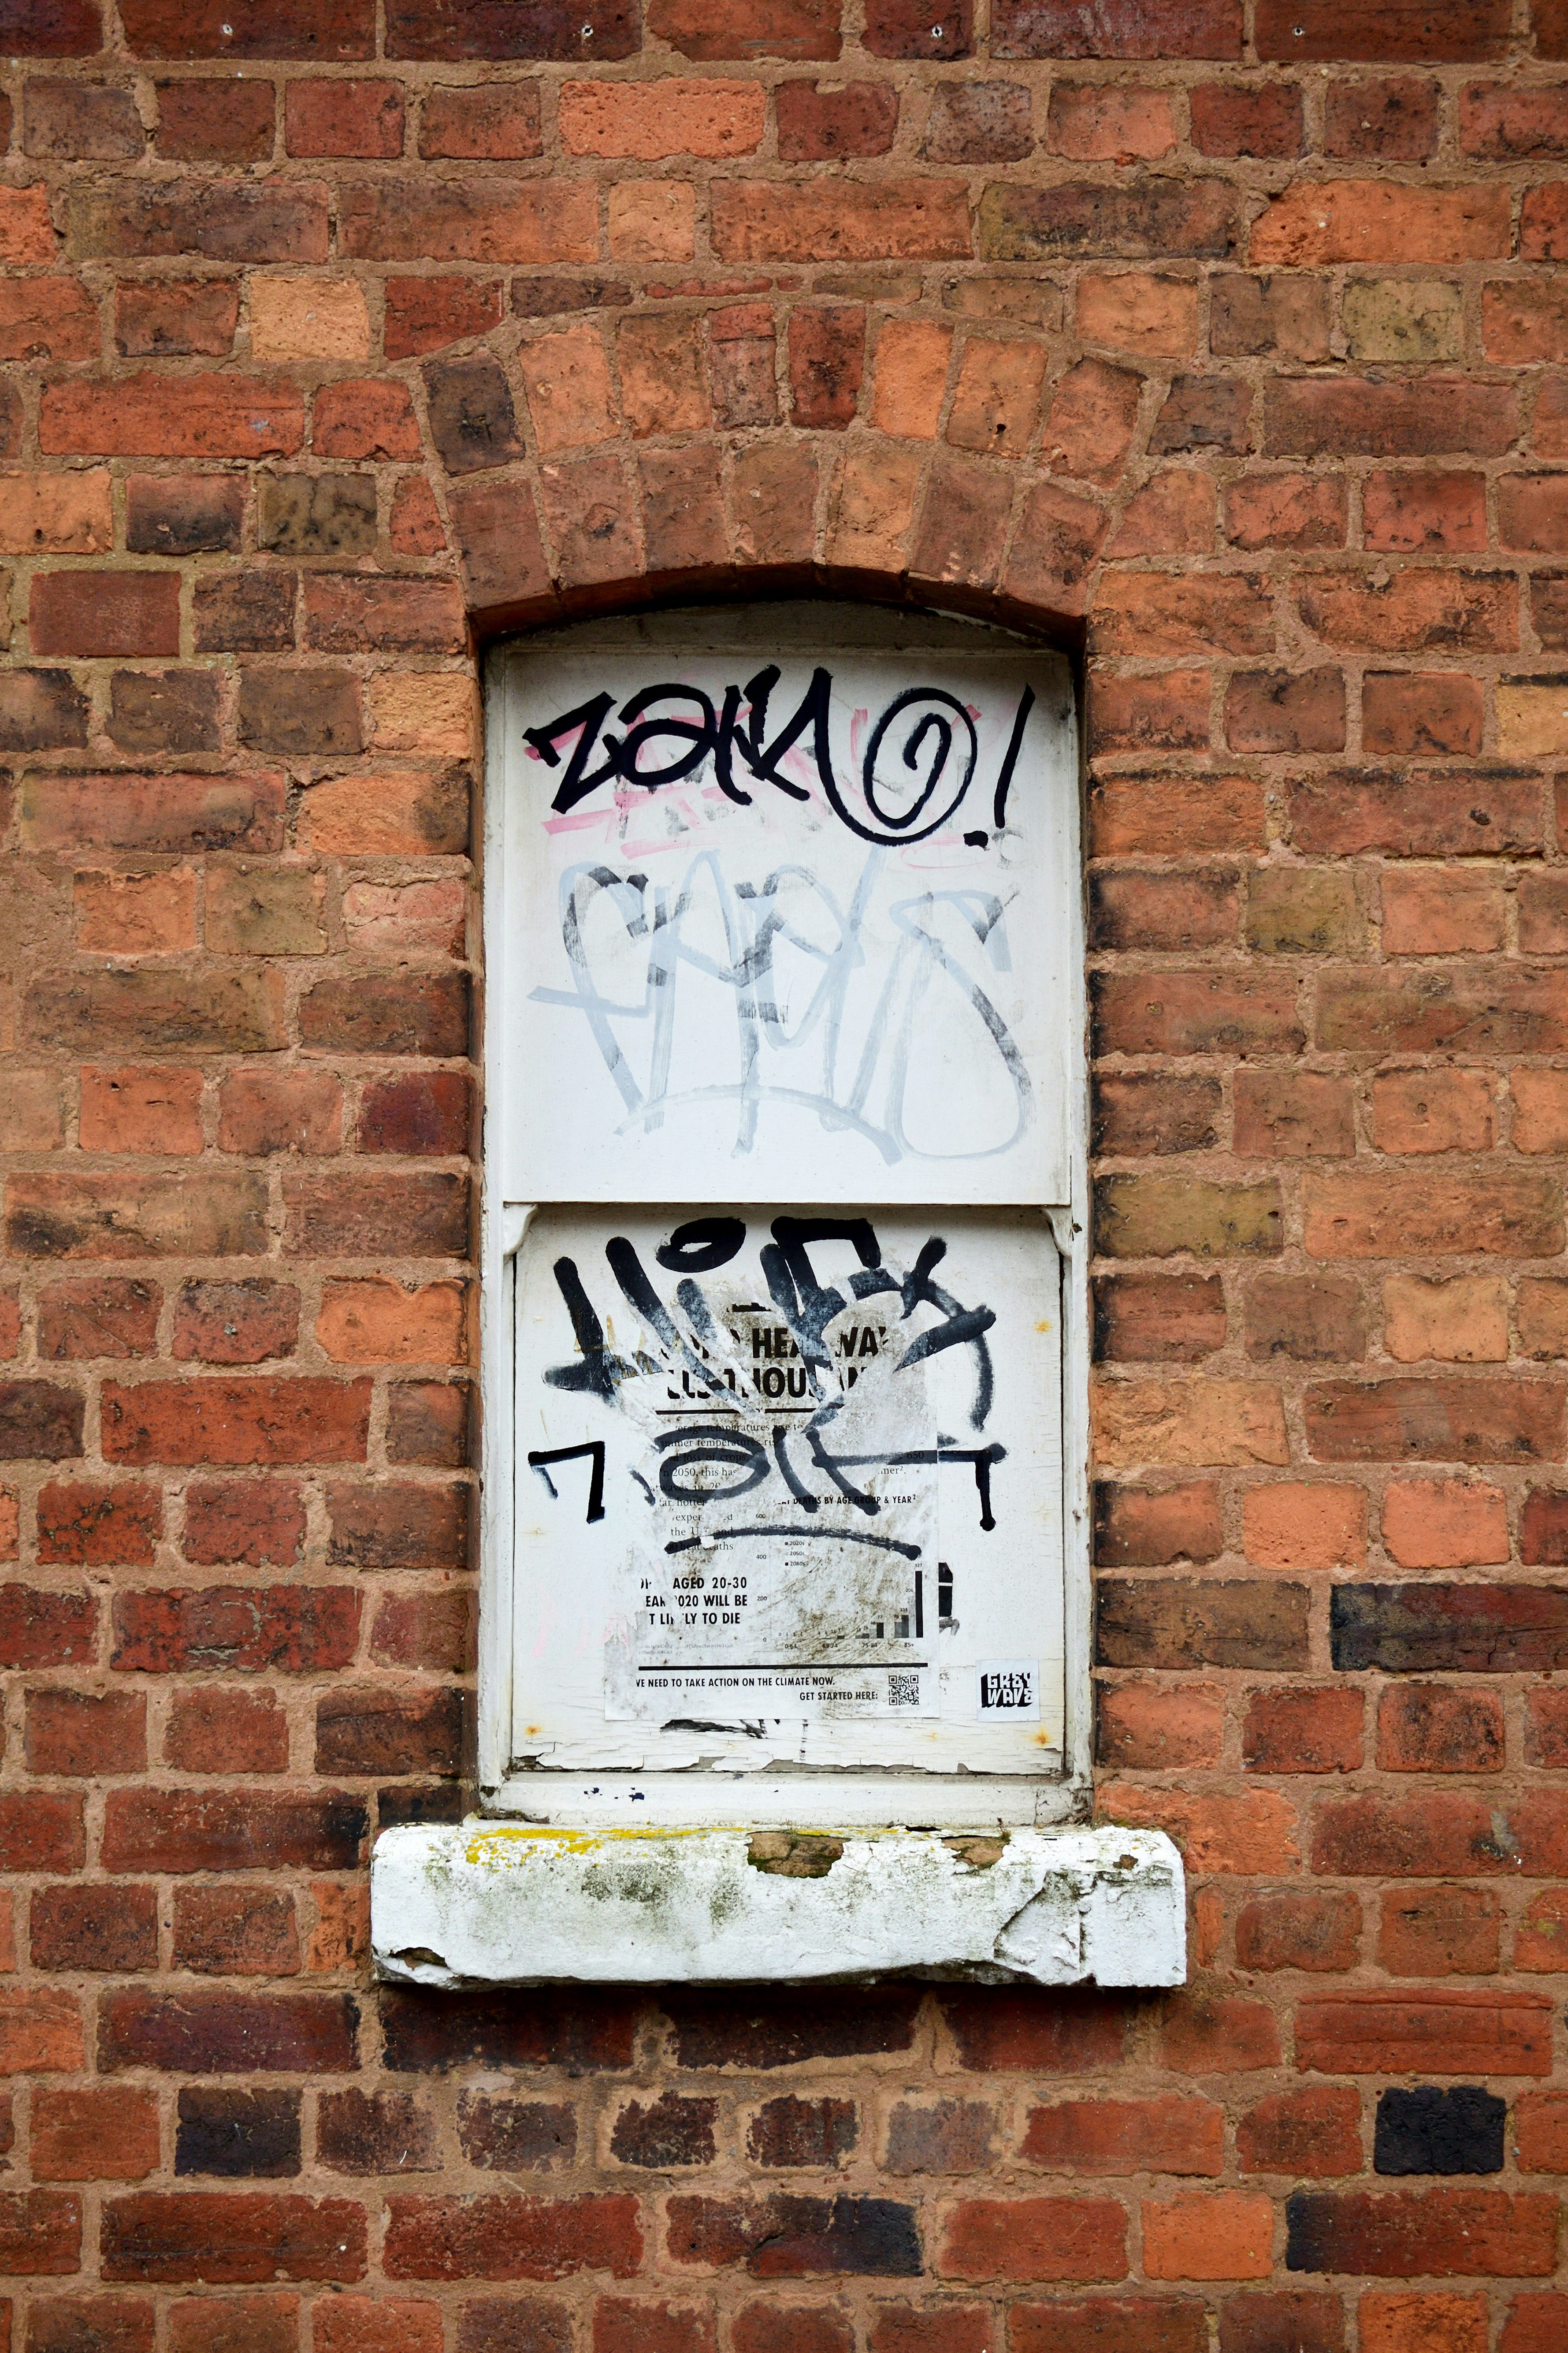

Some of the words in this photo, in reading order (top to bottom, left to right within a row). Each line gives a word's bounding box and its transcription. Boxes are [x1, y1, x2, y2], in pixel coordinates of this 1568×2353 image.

[707, 1423, 769, 1433] temperatures
[697, 1438, 762, 1448] temperatures
[684, 1452, 701, 1461] loss
[706, 1451, 716, 1460] of
[907, 1450, 924, 1459] 650
[673, 1468, 698, 1478] 2050,
[701, 1467, 719, 1476] this
[824, 1496, 834, 1504] BY
[837, 1496, 852, 1504] AGE
[855, 1496, 881, 1504] GROUP
[671, 1527, 686, 1536] the
[716, 1526, 733, 1535] and
[673, 1577, 704, 1589] AGED
[712, 1576, 747, 1589] 20-30
[674, 1595, 699, 1607] 020
[703, 1594, 730, 1607] WILL
[735, 1594, 747, 1606] BE
[702, 1612, 717, 1624] TO
[722, 1612, 740, 1624] DIE
[648, 1679, 668, 1687] NEED
[671, 1678, 682, 1687] TO
[685, 1678, 705, 1687] TAKE
[708, 1678, 739, 1687] ACTION
[742, 1678, 754, 1686] ON
[758, 1677, 773, 1686] THE
[775, 1677, 809, 1686] CLIMATE
[813, 1676, 835, 1685] NOW.
[799, 1692, 814, 1700] GET
[818, 1691, 853, 1700] STARTED
[856, 1691, 878, 1700] HERE:
